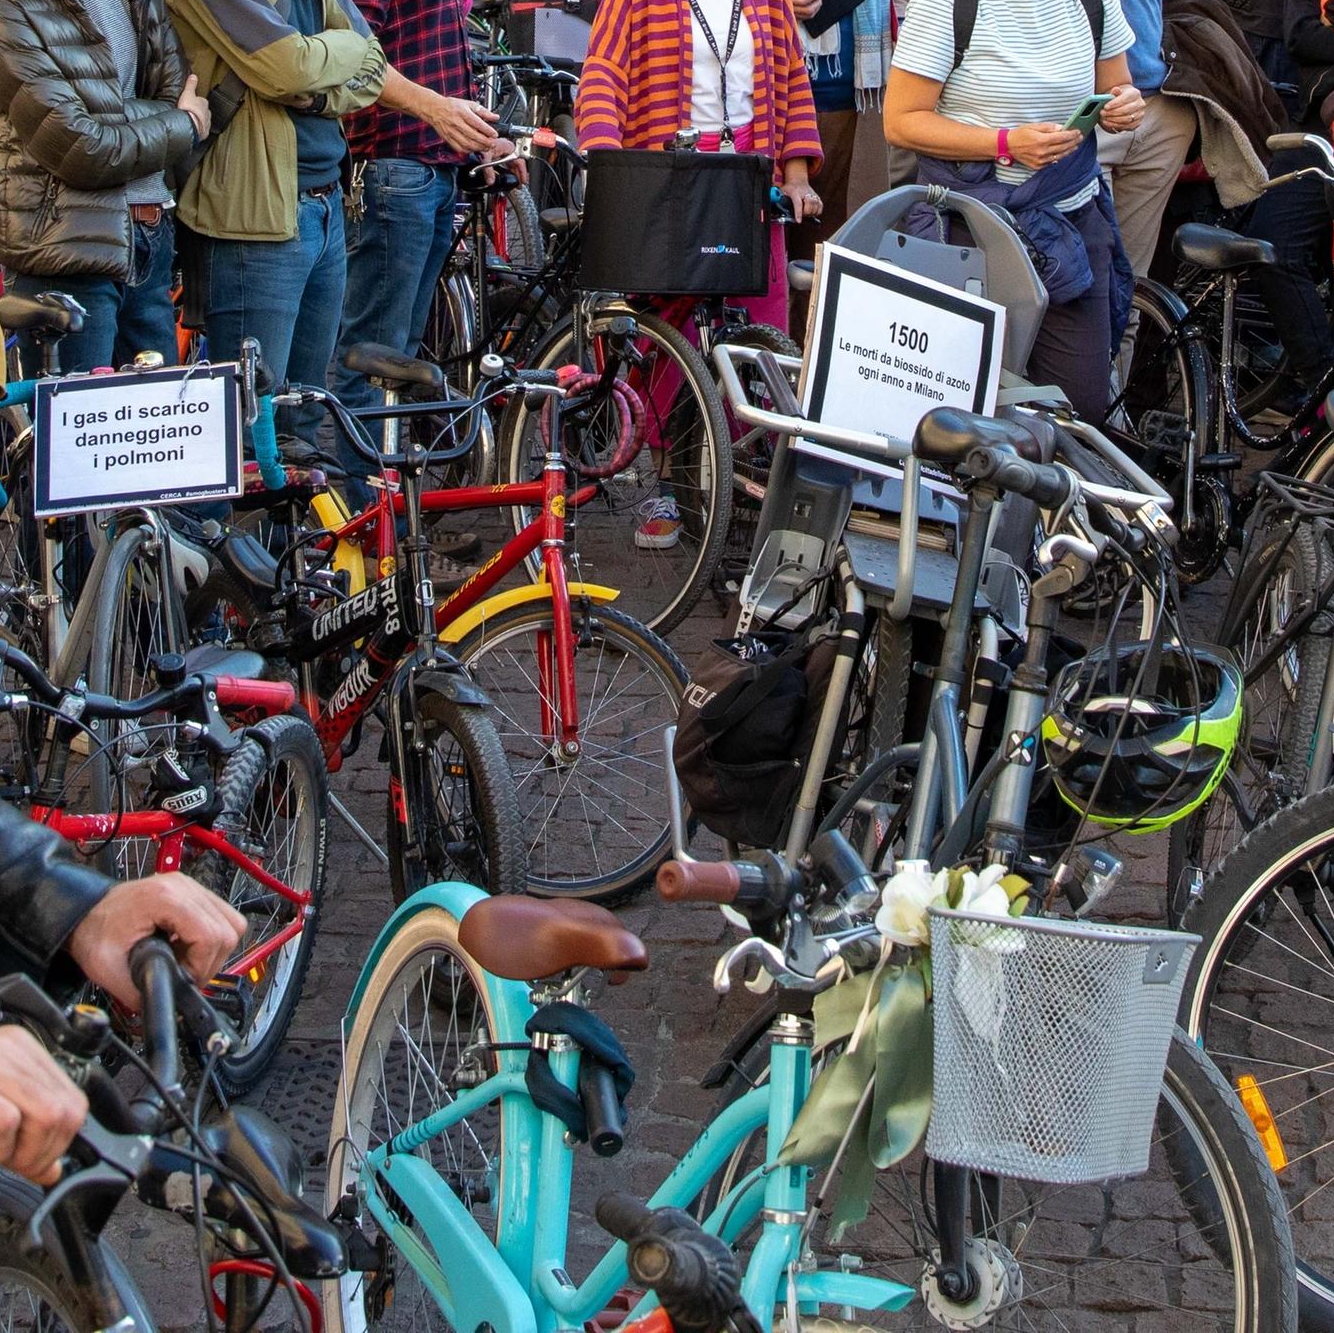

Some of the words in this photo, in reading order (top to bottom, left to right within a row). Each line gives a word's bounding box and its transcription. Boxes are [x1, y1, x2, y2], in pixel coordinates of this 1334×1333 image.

[889, 321, 929, 354] 1500
[839, 337, 851, 351] Le
[853, 344, 879, 361] morti
[880, 352, 892, 365] da
[894, 355, 934, 379] biossido
[935, 371, 945, 384] di
[946, 376, 971, 392] azoto
[858, 365, 879, 381] ogni
[881, 372, 904, 389] anno
[906, 381, 912, 391] a
[914, 381, 945, 402] Milano
[62, 411, 67, 427] I
[73, 410, 108, 429] gas
[114, 405, 132, 421] di
[138, 400, 210, 419] scarico
[75, 424, 203, 448] danneggiano
[93, 453, 98, 468] i
[105, 445, 185, 471] polmoni
[160, 491, 182, 500] CERCA
[311, 585, 379, 642] UNITED
[379, 575, 401, 636] FR18
[328, 658, 379, 719] VIGOUR
[167, 789, 203, 810] ABUS
